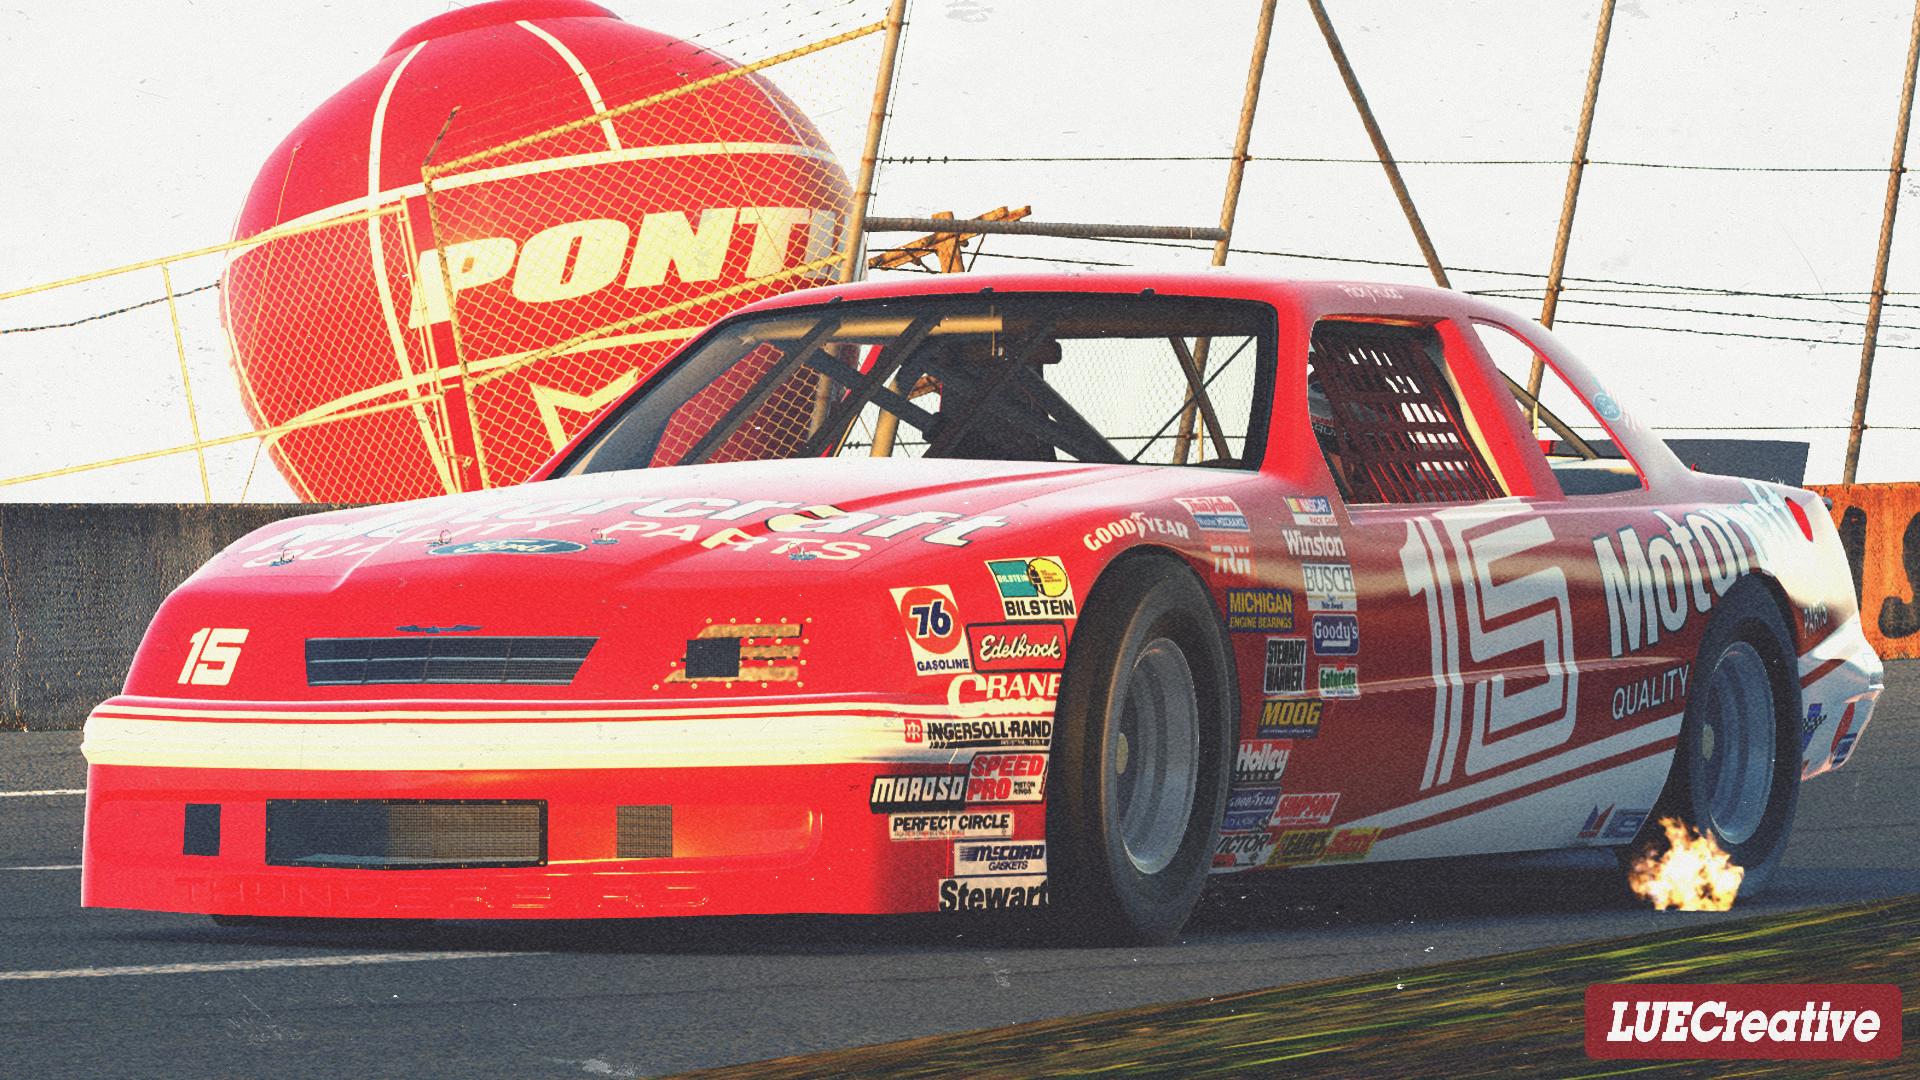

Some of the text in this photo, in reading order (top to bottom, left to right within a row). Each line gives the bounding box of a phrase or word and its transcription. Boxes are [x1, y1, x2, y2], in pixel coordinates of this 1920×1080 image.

[409, 207, 847, 328] PONTI
[600, 521, 871, 560] PARTS
[1282, 530, 1346, 557] Winston
[1303, 565, 1355, 592] BUSCH
[1005, 600, 1074, 616] BILSTEIN
[1230, 592, 1292, 614] MICHIGAN
[911, 599, 951, 637] 76
[1230, 616, 1292, 629] ENGINE BEARINGS
[1314, 621, 1358, 640] Goody's
[178, 627, 249, 686] 15
[979, 633, 1061, 661] Edelbrock
[1399, 497, 1579, 790] 15
[917, 658, 969, 671] GASOLINE
[947, 673, 1061, 712] CRANE
[1612, 665, 1689, 720] QUALITY
[1261, 702, 1322, 726] MOOG
[927, 720, 1051, 740] INGERSOLL-RAND
[971, 754, 1046, 776] SPEED
[1236, 744, 1290, 779] Holley
[872, 777, 964, 802] MOROSO
[967, 778, 1011, 800] PRO
[893, 813, 1010, 832] PERFECT CIRCLE
[988, 860, 1028, 871] GASKETS
[940, 880, 1049, 911] Stewart
